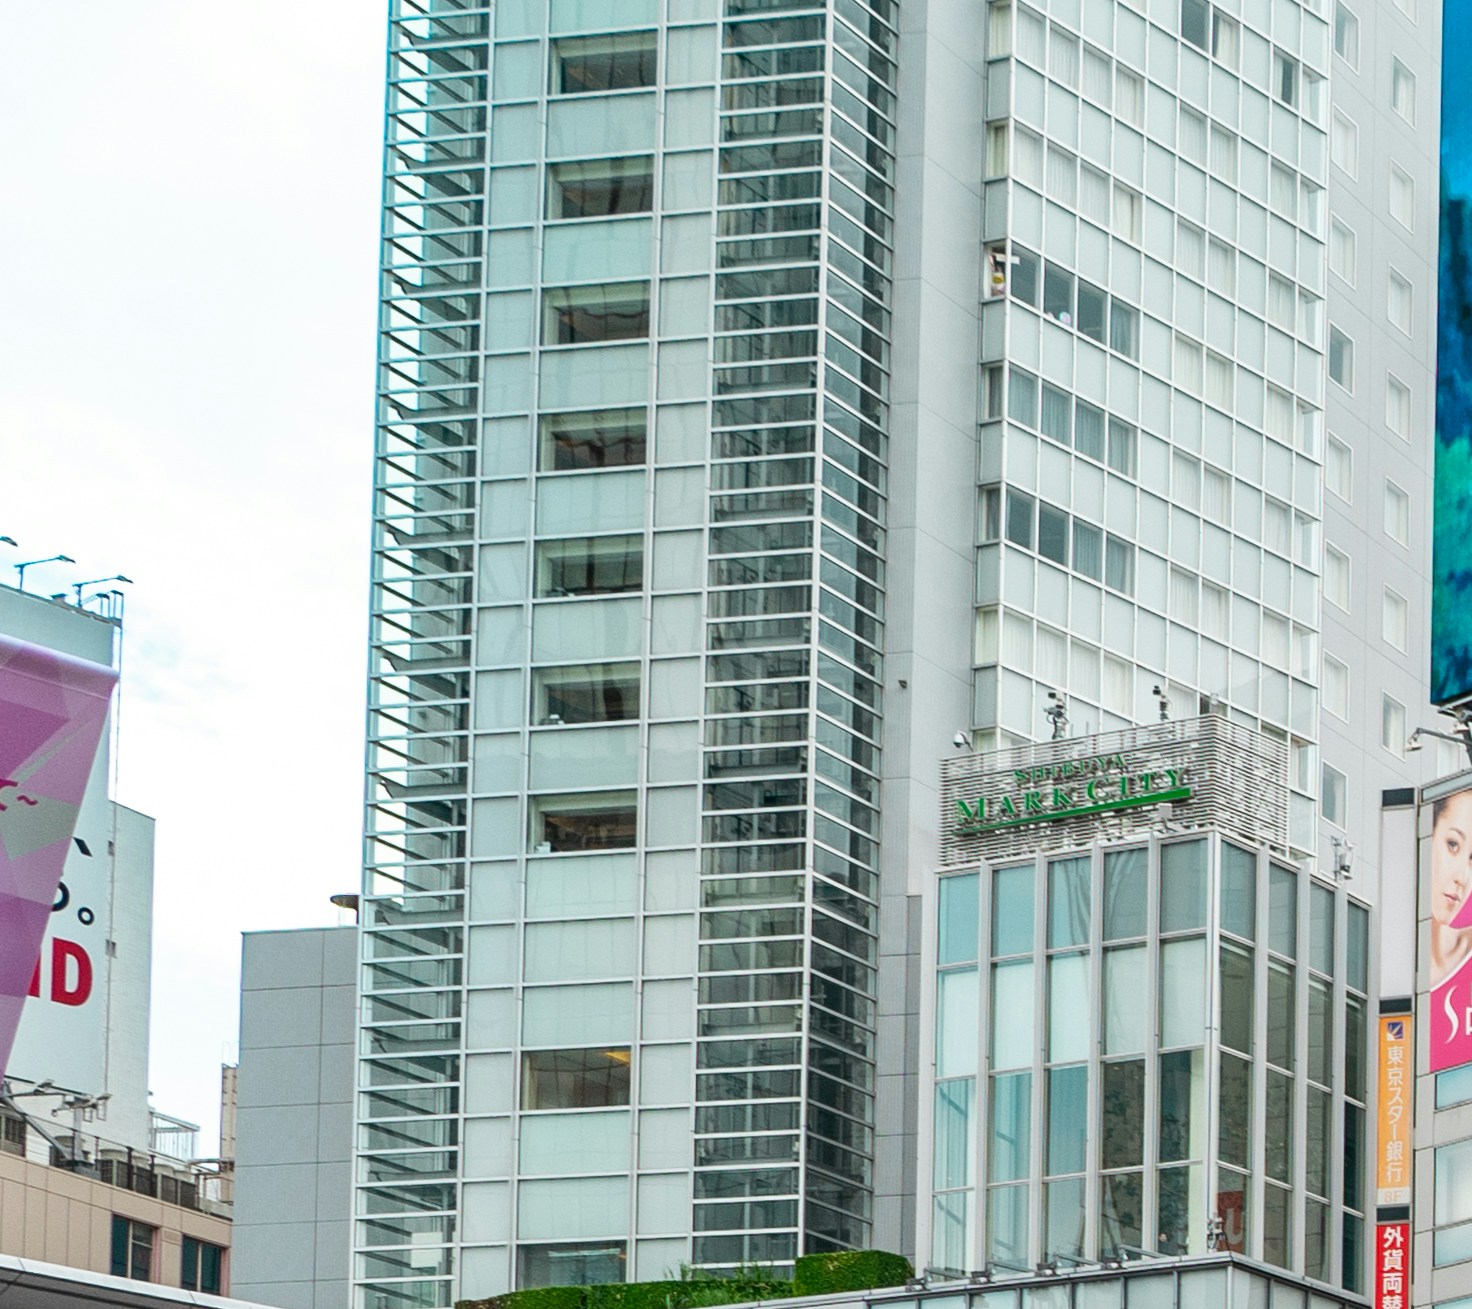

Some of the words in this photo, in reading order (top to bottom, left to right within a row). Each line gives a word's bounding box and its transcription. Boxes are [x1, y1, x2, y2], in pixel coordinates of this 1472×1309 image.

[955, 791, 1073, 823] MARK
[1087, 768, 1188, 805] CITY
[1013, 753, 1126, 784] SHIBUYA
[1386, 1045, 1404, 1184] 東京スター銀行
